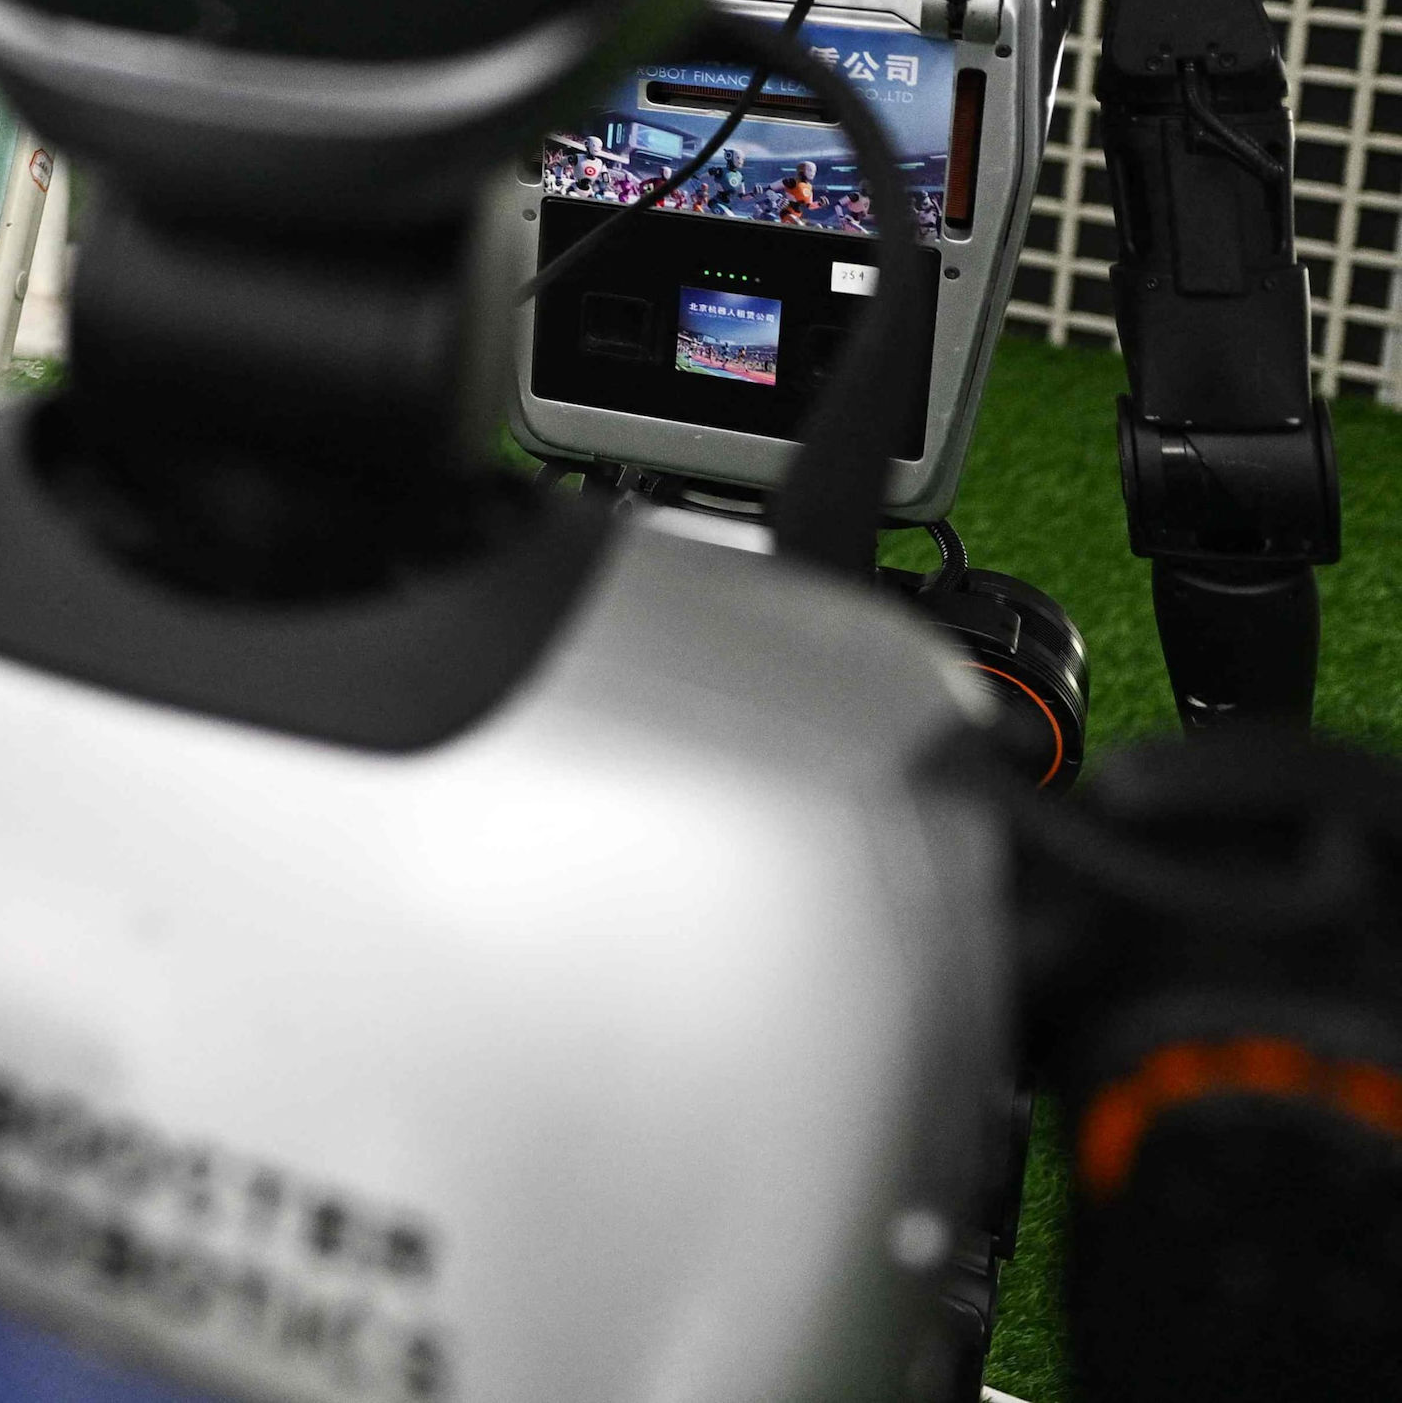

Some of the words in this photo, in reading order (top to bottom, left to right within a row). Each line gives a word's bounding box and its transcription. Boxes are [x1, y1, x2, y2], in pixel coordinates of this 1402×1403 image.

[689, 302, 775, 323] 北京机器人租赁公司
